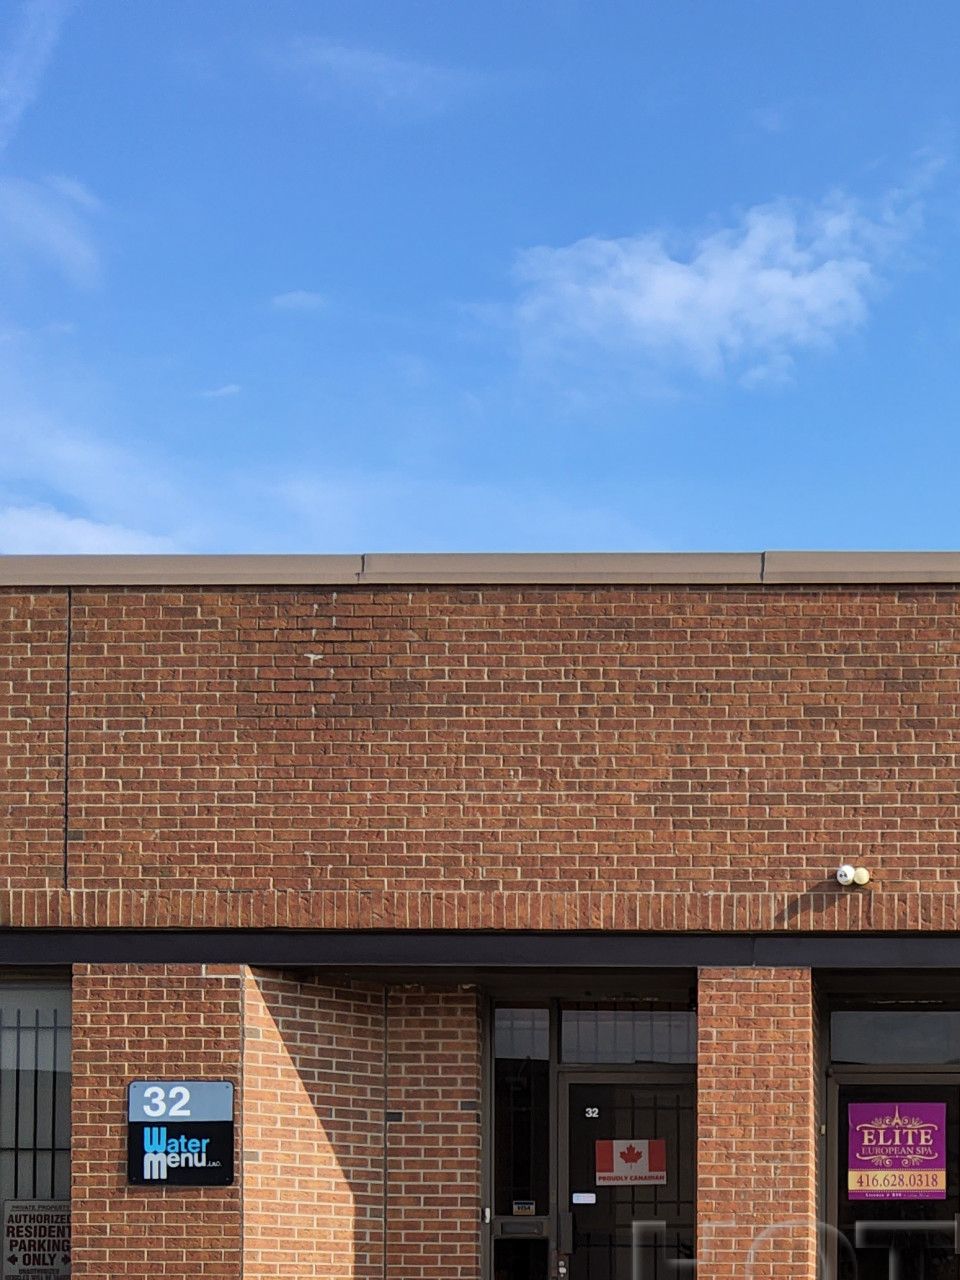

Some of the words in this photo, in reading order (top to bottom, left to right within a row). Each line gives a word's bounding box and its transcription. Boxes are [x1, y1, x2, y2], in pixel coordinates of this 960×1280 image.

[143, 1086, 191, 1117] 32
[585, 1108, 600, 1118] 32
[143, 1127, 210, 1153] Water
[862, 1129, 933, 1146] ELITE
[862, 1147, 914, 1155] EUROPEAN
[915, 1147, 933, 1155] SPA
[856, 1173, 938, 1188] 416.628.0318
[9, 1239, 71, 1252] PARKING
[22, 1253, 57, 1266] ONLY
